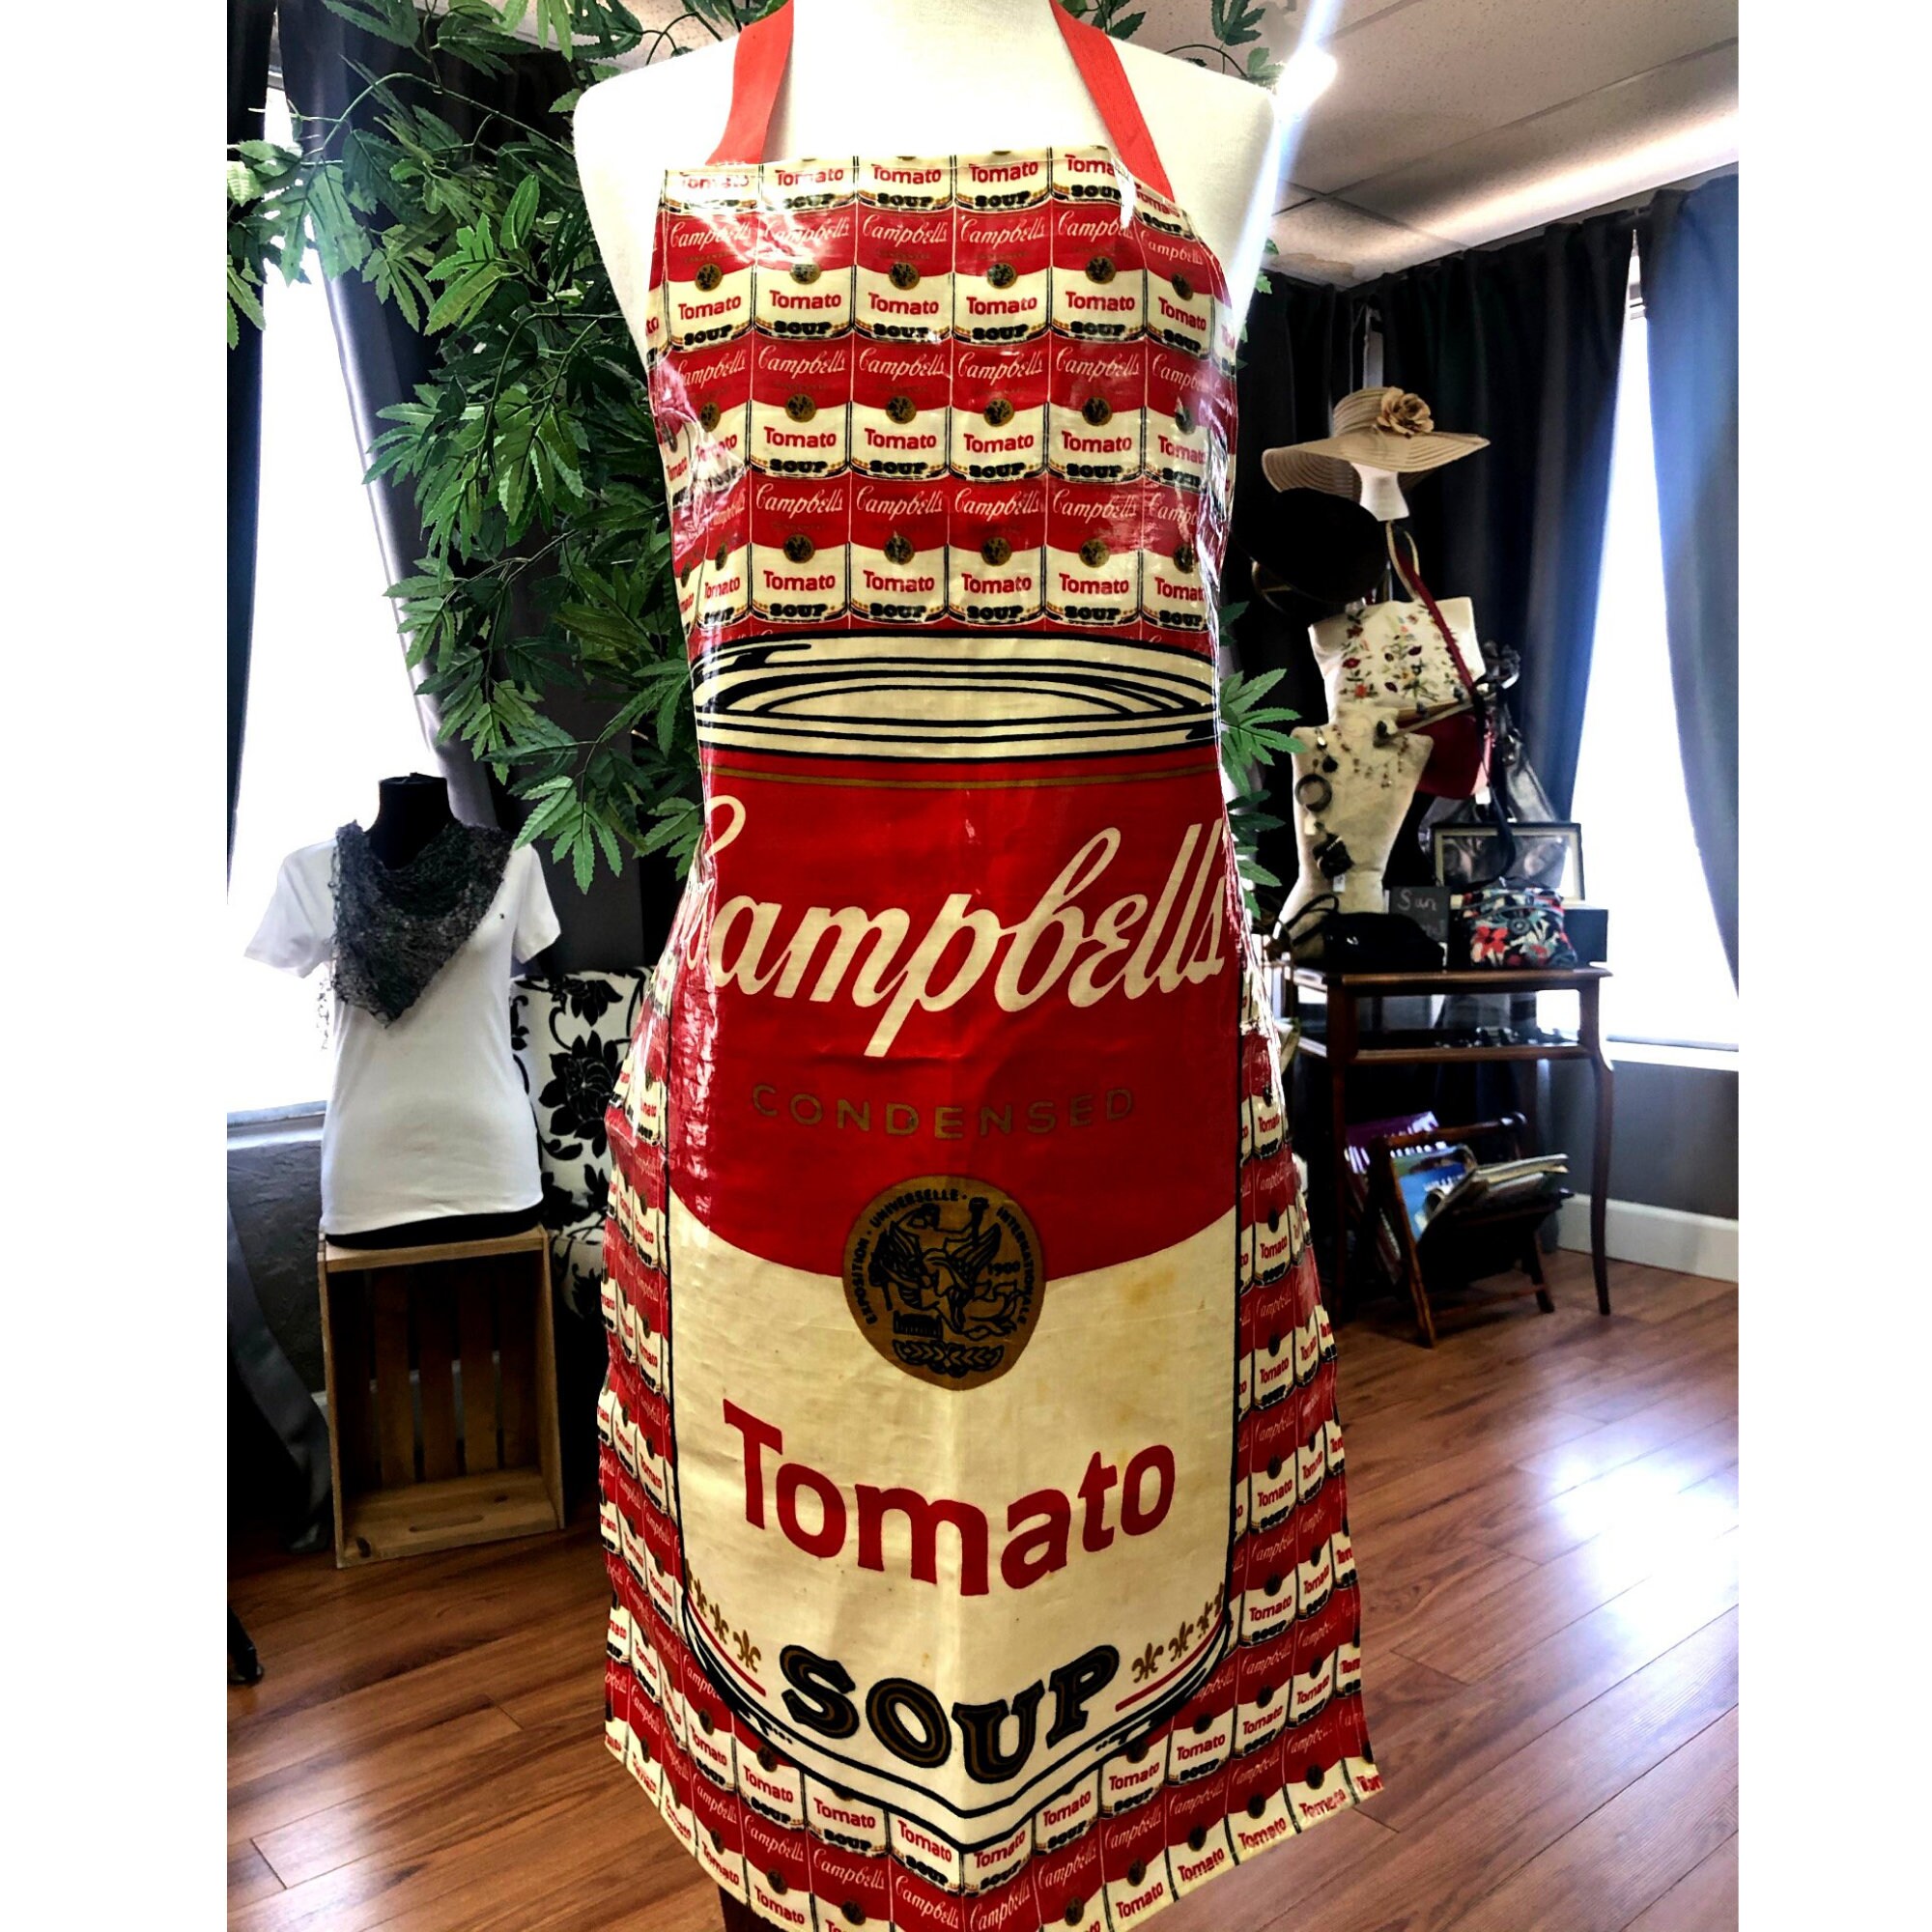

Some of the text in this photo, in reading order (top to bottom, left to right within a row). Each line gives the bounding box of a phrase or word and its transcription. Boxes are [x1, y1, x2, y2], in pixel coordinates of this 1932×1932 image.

[873, 164, 942, 184] Tomato
[969, 160, 1038, 183] Tomato
[1065, 154, 1115, 177] Toma
[877, 193, 933, 207] SOUP
[975, 190, 1030, 207] SOUP
[678, 296, 741, 320] Tomato
[770, 290, 841, 309] Tomato
[868, 293, 939, 315] Tomato
[966, 296, 1037, 315] Tomato
[1065, 291, 1135, 311] Tomato
[1158, 298, 1207, 331] Tomato
[684, 325, 732, 346] SOUP
[774, 321, 832, 334] SOUP
[972, 324, 1028, 340] SOUP
[1070, 321, 1125, 336] SOUP
[1163, 328, 1202, 353] SOUP
[764, 427, 837, 448] Tomato
[865, 428, 937, 450] Tomato
[963, 433, 1035, 453] Tomato
[1062, 431, 1132, 453] Tomato
[770, 460, 827, 473] SOUP
[869, 460, 927, 475] SOUP
[969, 463, 1025, 478] SOUP
[1065, 464, 1122, 478] SOUP
[763, 570, 836, 591] Tomato
[863, 570, 935, 592] Tomato
[961, 573, 1032, 594] Tomato
[1059, 573, 1129, 594] Tomato
[770, 603, 828, 618] SOUP
[869, 603, 927, 618] SOUP
[967, 605, 1024, 620] SOUP
[1065, 606, 1121, 620] SOUP
[1397, 888, 1436, 911] Sun
[752, 1084, 1133, 1140] CONDENSED
[1260, 1235, 1288, 1259] Tomato
[1260, 1357, 1290, 1384] Tomato
[724, 1398, 1175, 1597] Tomato
[1258, 1479, 1293, 1507] Tomato
[1249, 1596, 1293, 1622] Tomato
[1296, 1674, 1330, 1704] Tomato
[779, 1644, 1121, 1784] SOUP
[1243, 1706, 1284, 1735] Tomato
[691, 1724, 727, 1766] Tomato
[1177, 1734, 1226, 1761] Tomato
[743, 1764, 793, 1804] Tomato
[1109, 1762, 1160, 1791] Tomato
[813, 1797, 876, 1829] Tomato
[1043, 1791, 1092, 1827] Tomato
[897, 1820, 952, 1862] Tomato
[1238, 1817, 1287, 1850] Tomato
[974, 1831, 1026, 1868] Tomato
[702, 1840, 740, 1886] Tomato
[1178, 1847, 1225, 1882] Tomato
[754, 1886, 806, 1925] Tomato
[1116, 1882, 1164, 1919] Tomato
